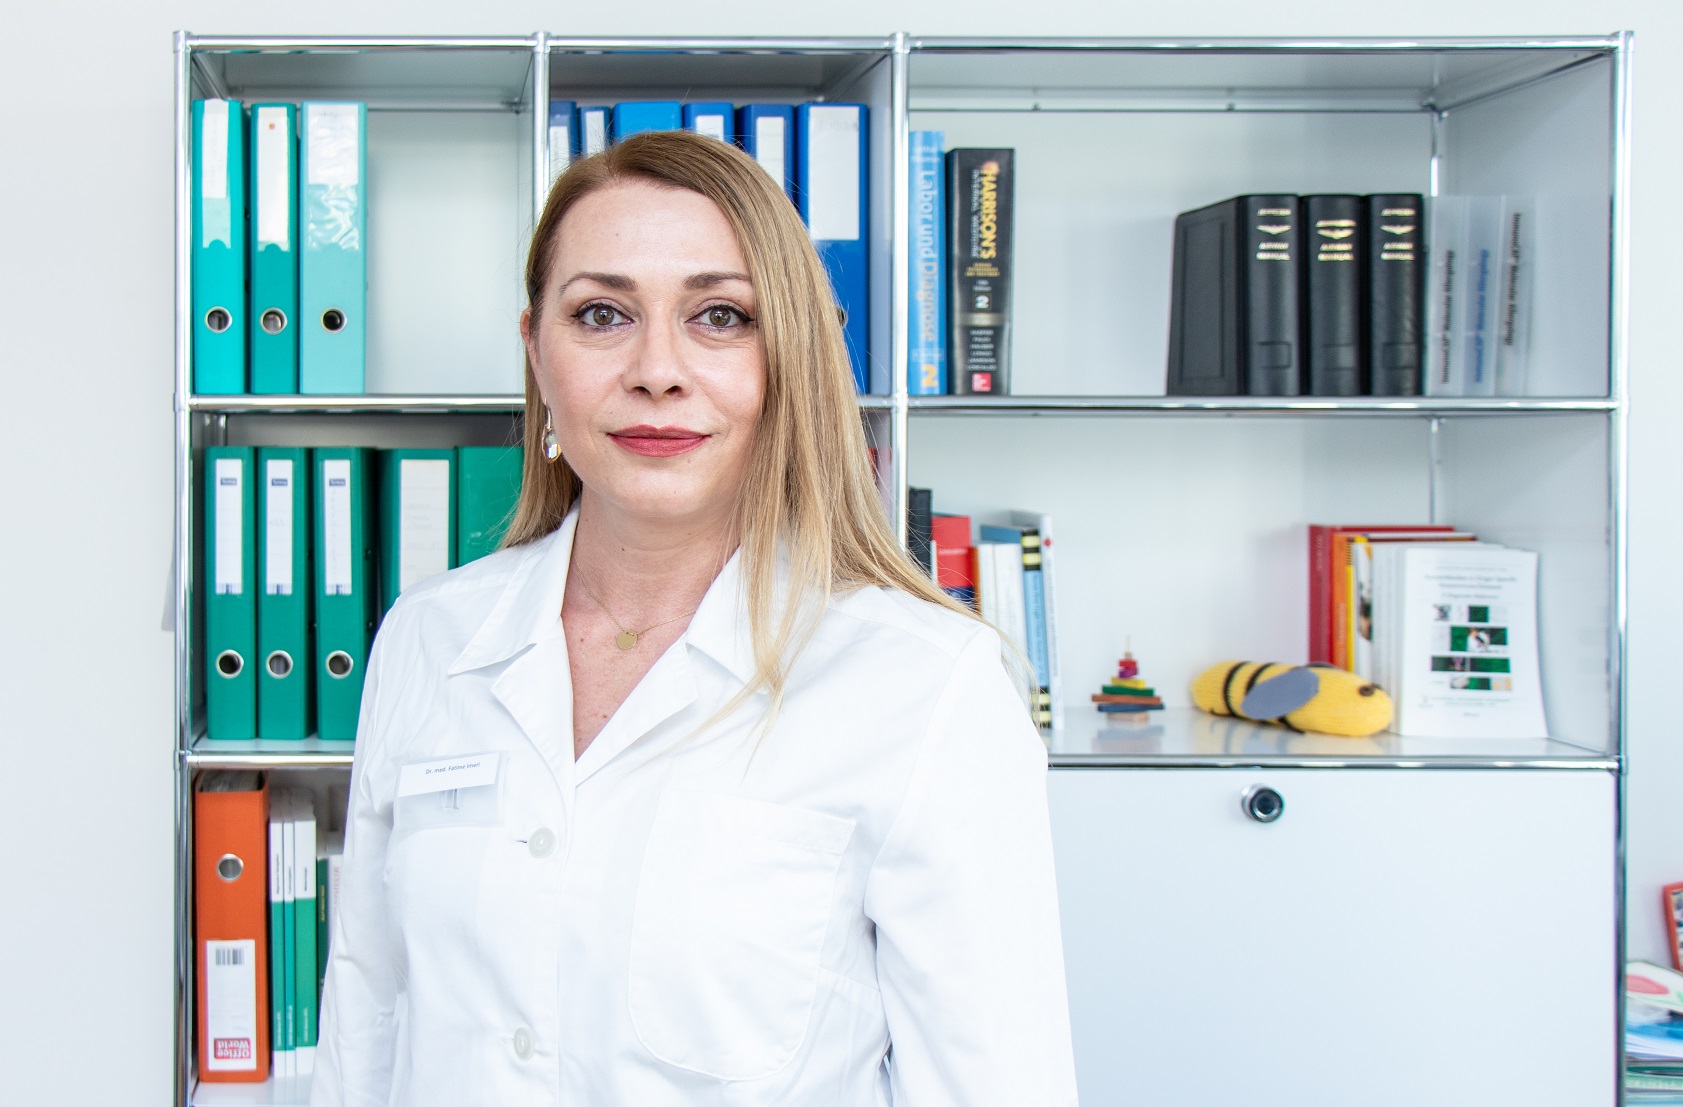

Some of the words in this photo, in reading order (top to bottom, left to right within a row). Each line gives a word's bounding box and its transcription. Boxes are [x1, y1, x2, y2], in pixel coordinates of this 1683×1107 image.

[920, 170, 938, 221] Labor
[981, 169, 997, 259] HARRISON'S
[920, 225, 937, 258] und
[916, 261, 938, 342] Diagnose
[975, 295, 989, 308] 2
[921, 364, 938, 387] 2
[217, 1040, 249, 1049] World
[217, 1049, 250, 1058] Office
